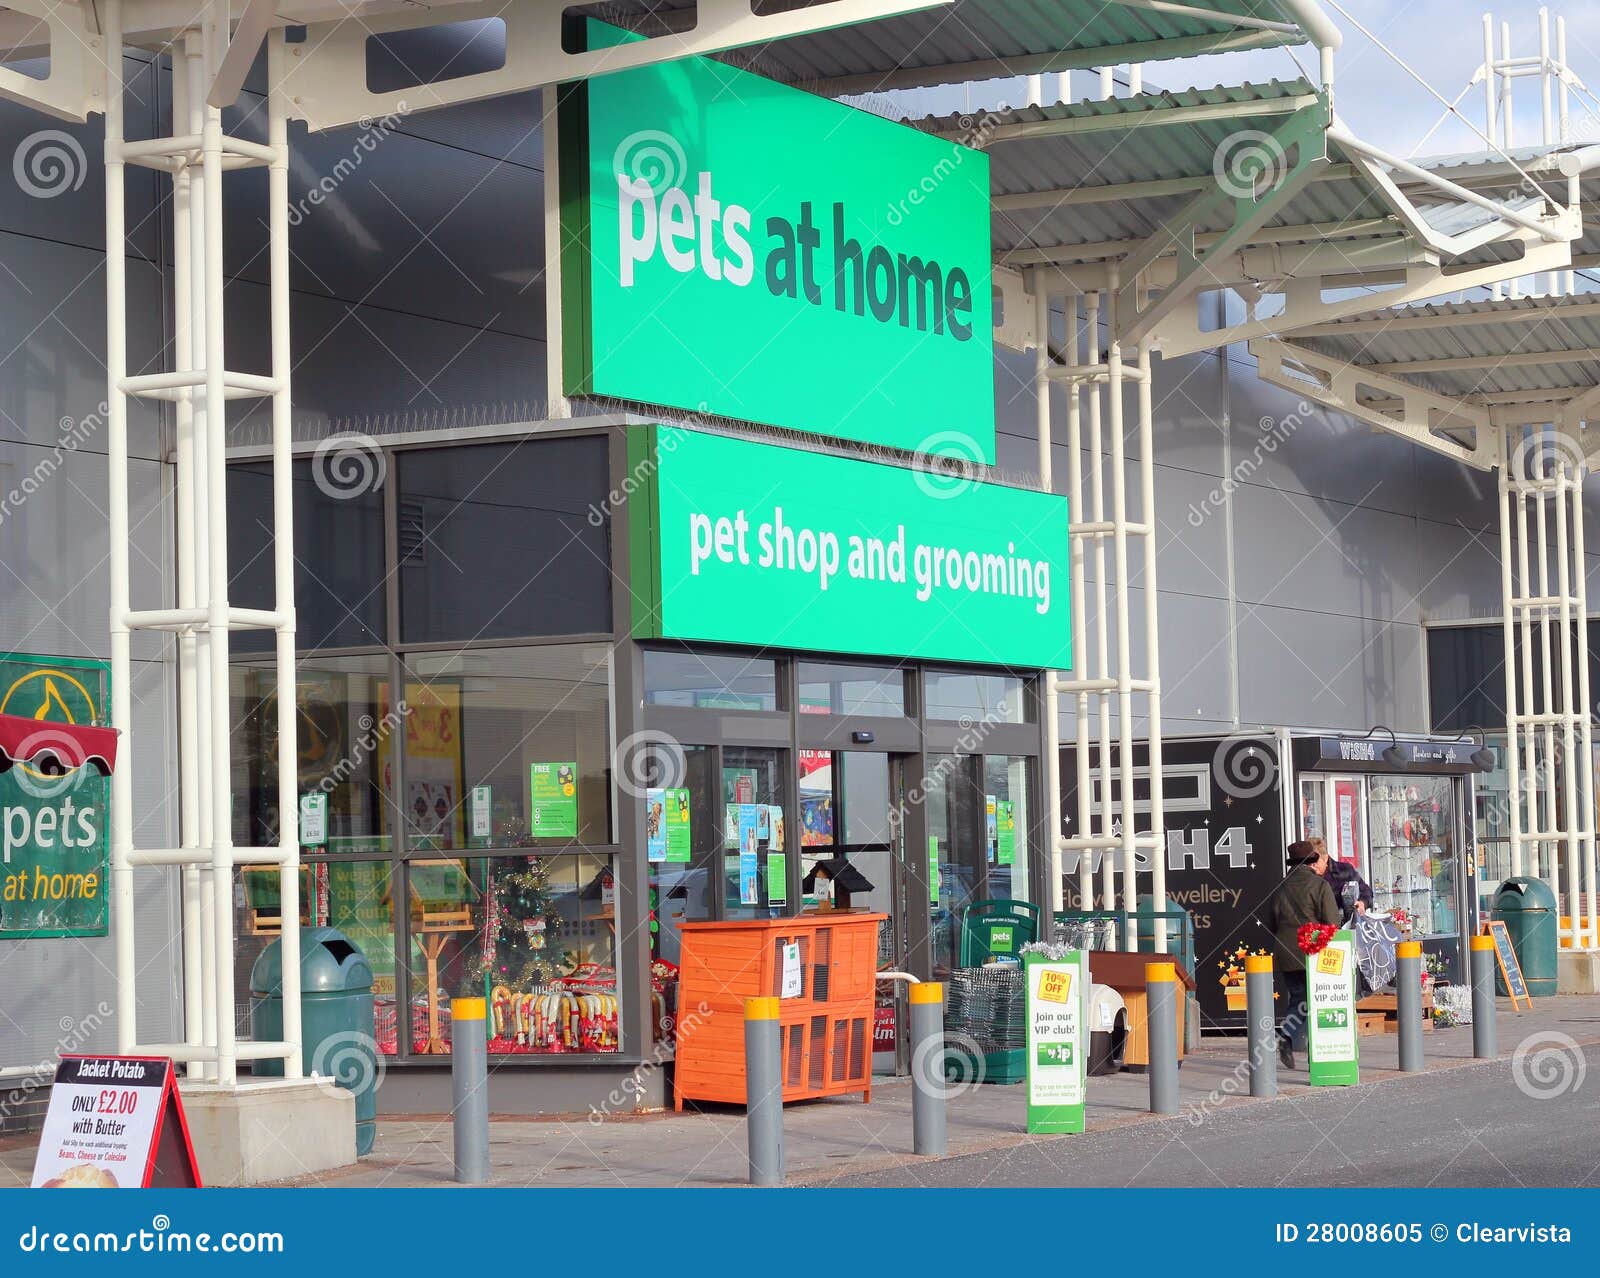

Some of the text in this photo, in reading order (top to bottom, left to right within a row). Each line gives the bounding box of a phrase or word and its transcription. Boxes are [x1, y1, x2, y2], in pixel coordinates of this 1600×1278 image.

[617, 171, 974, 342] pets at home
[689, 506, 1051, 615] pet shop and grooming
[3, 796, 97, 862] pets
[4, 865, 98, 900] at home
[992, 932, 1010, 942] pets
[1322, 957, 1337, 967] OFF
[1045, 972, 1066, 984] 10%
[1045, 982, 1063, 994] OFF
[1315, 983, 1331, 992] Join
[1314, 993, 1349, 1002] VIP club!
[1035, 1012, 1073, 1024] Join our
[1034, 1025, 1075, 1035] VIP club!
[1047, 1044, 1071, 1062] vip
[77, 1059, 145, 1079] Jacket Potato
[72, 1089, 138, 1114] ONLY £2.00
[73, 1117, 126, 1136] with Butter
[58, 1148, 127, 1162] Beans, Cheese or Coleslaw
